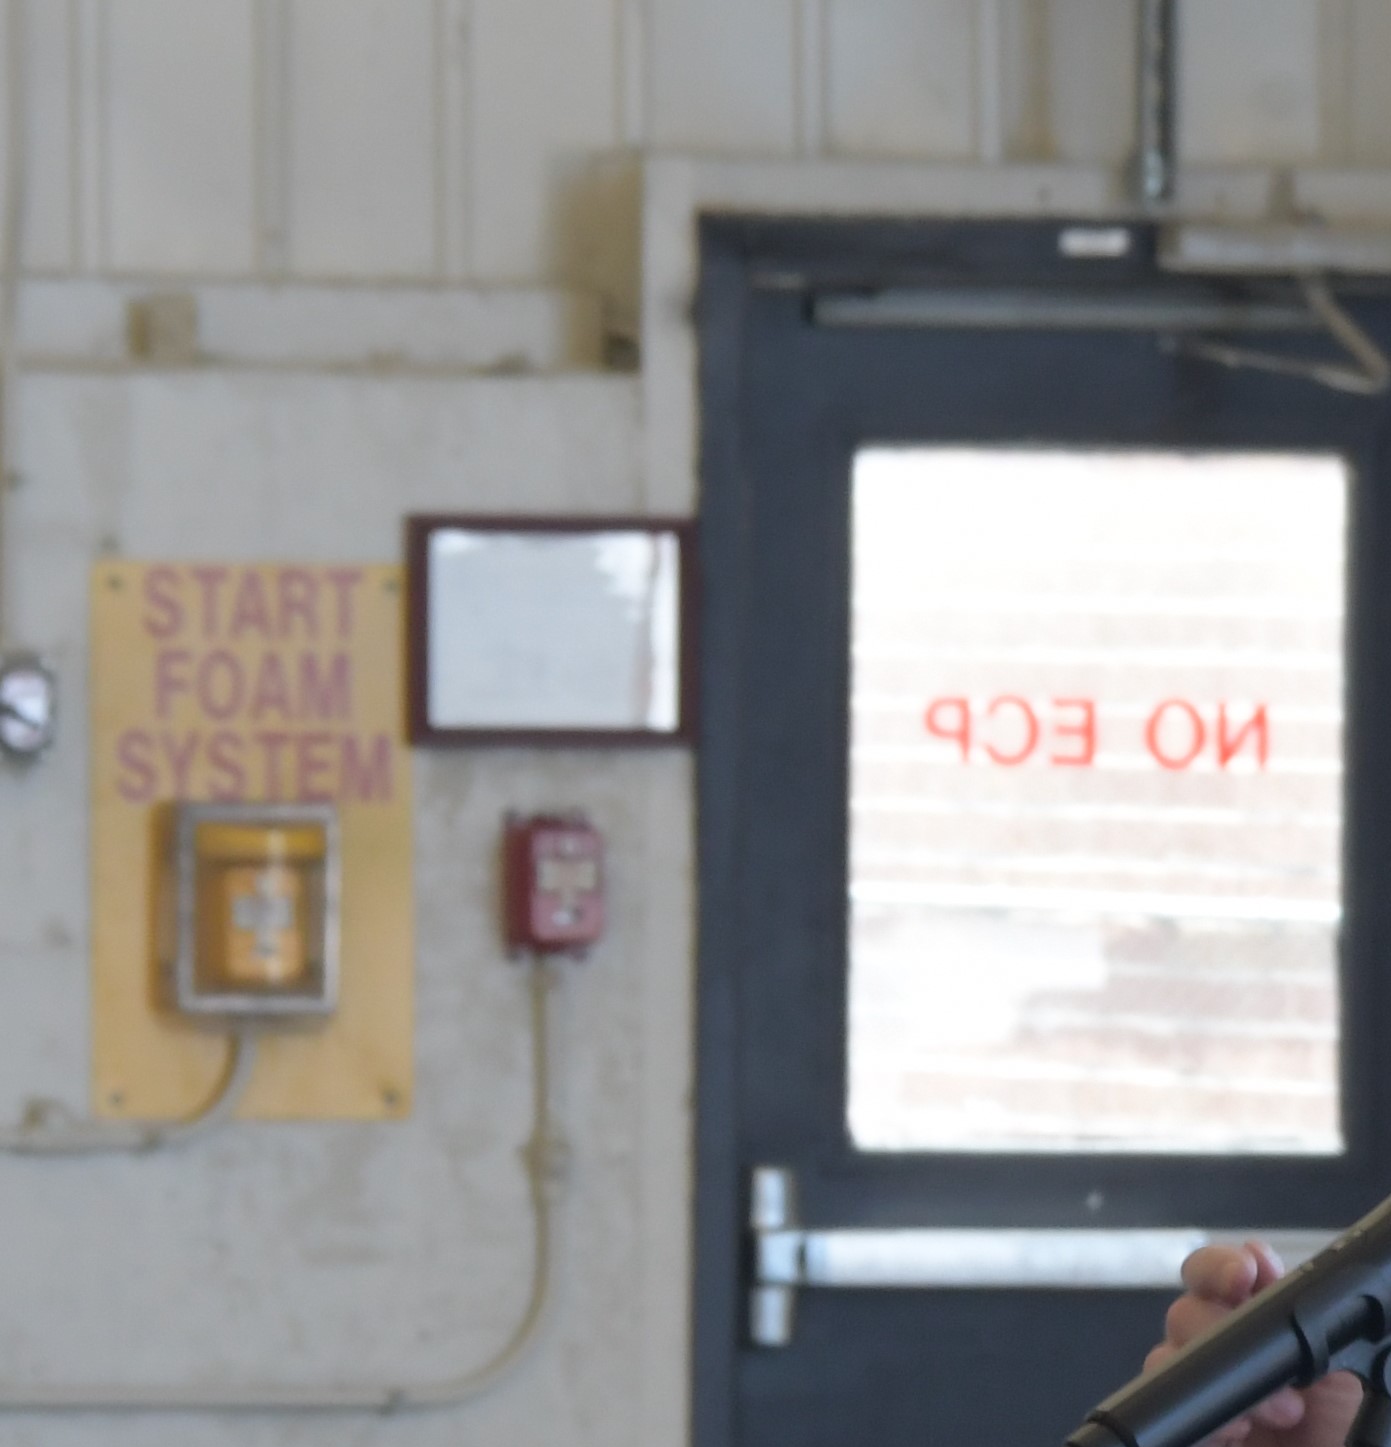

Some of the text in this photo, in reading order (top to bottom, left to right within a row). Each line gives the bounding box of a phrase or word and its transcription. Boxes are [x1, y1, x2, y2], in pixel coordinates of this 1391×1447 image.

[143, 568, 363, 639] START
[154, 650, 353, 721] FOAM
[116, 731, 394, 803] SYSTEM
